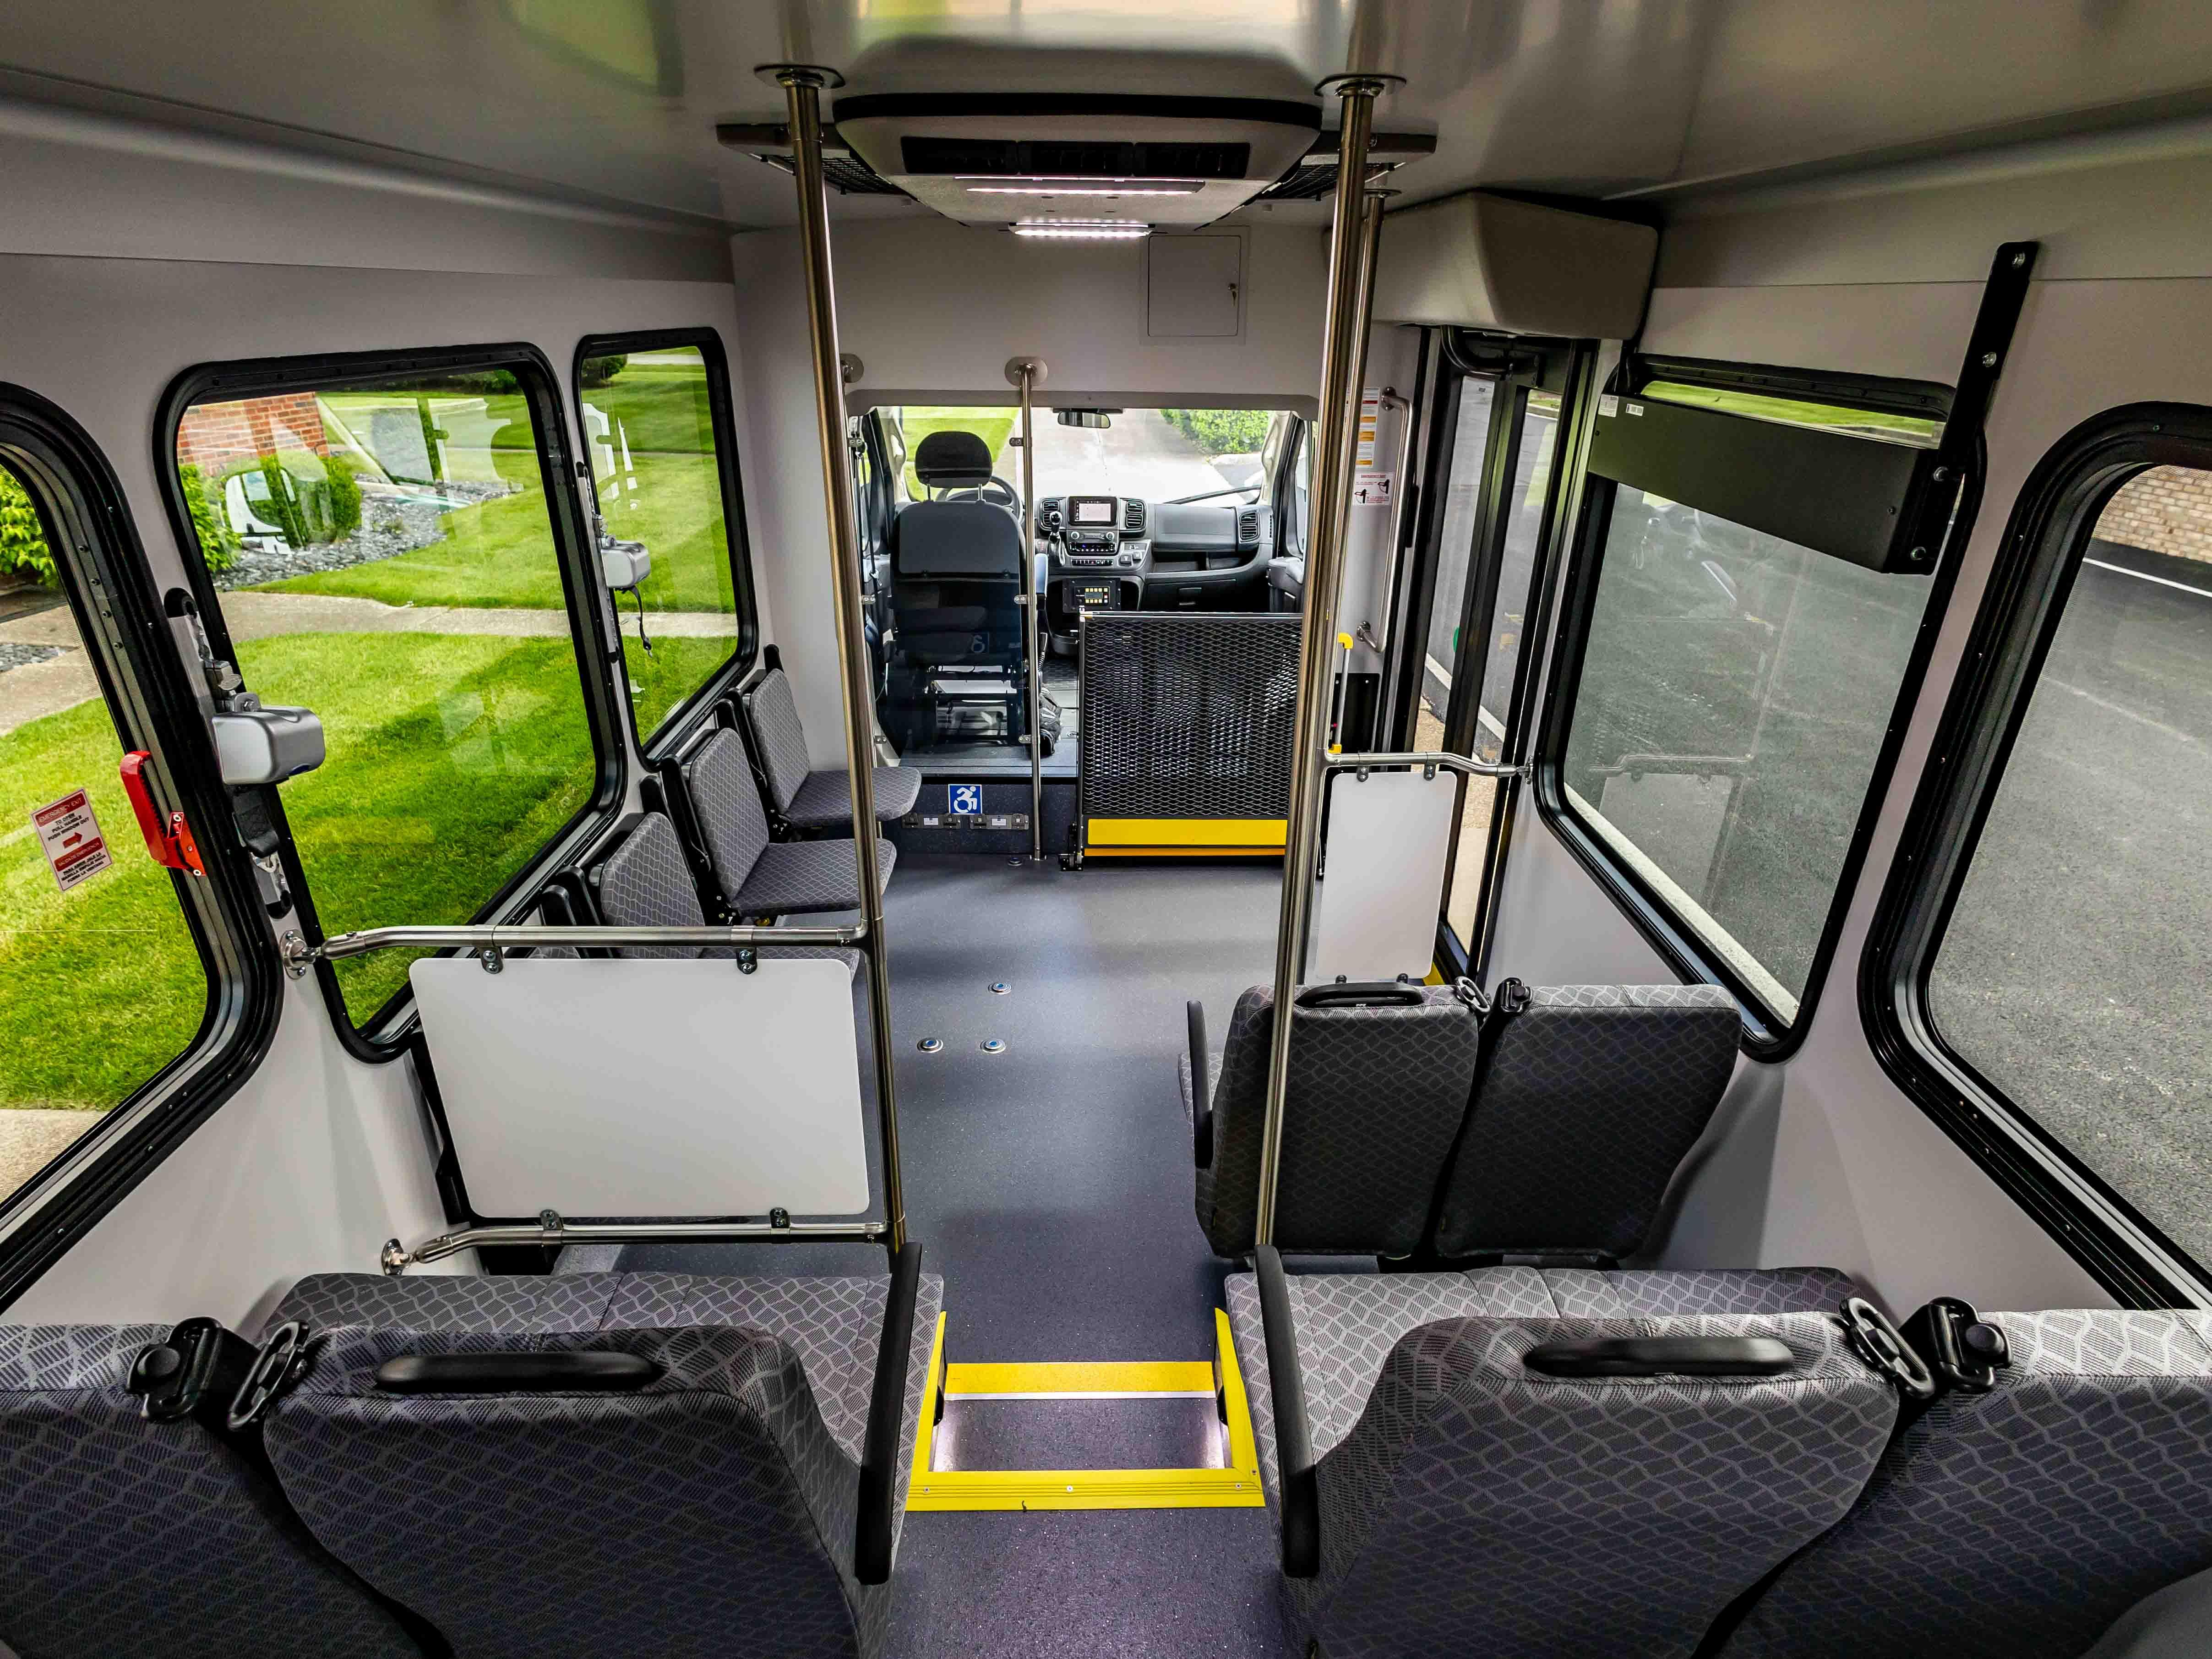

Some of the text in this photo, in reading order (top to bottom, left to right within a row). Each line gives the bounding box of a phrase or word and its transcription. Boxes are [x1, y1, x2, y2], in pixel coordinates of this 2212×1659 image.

[71, 797, 82, 806] EXIT
[51, 814, 82, 833] PULL HANDLE
[61, 812, 75, 822] OPEN
[47, 831, 61, 841] PUSH
[79, 816, 90, 824] OUT
